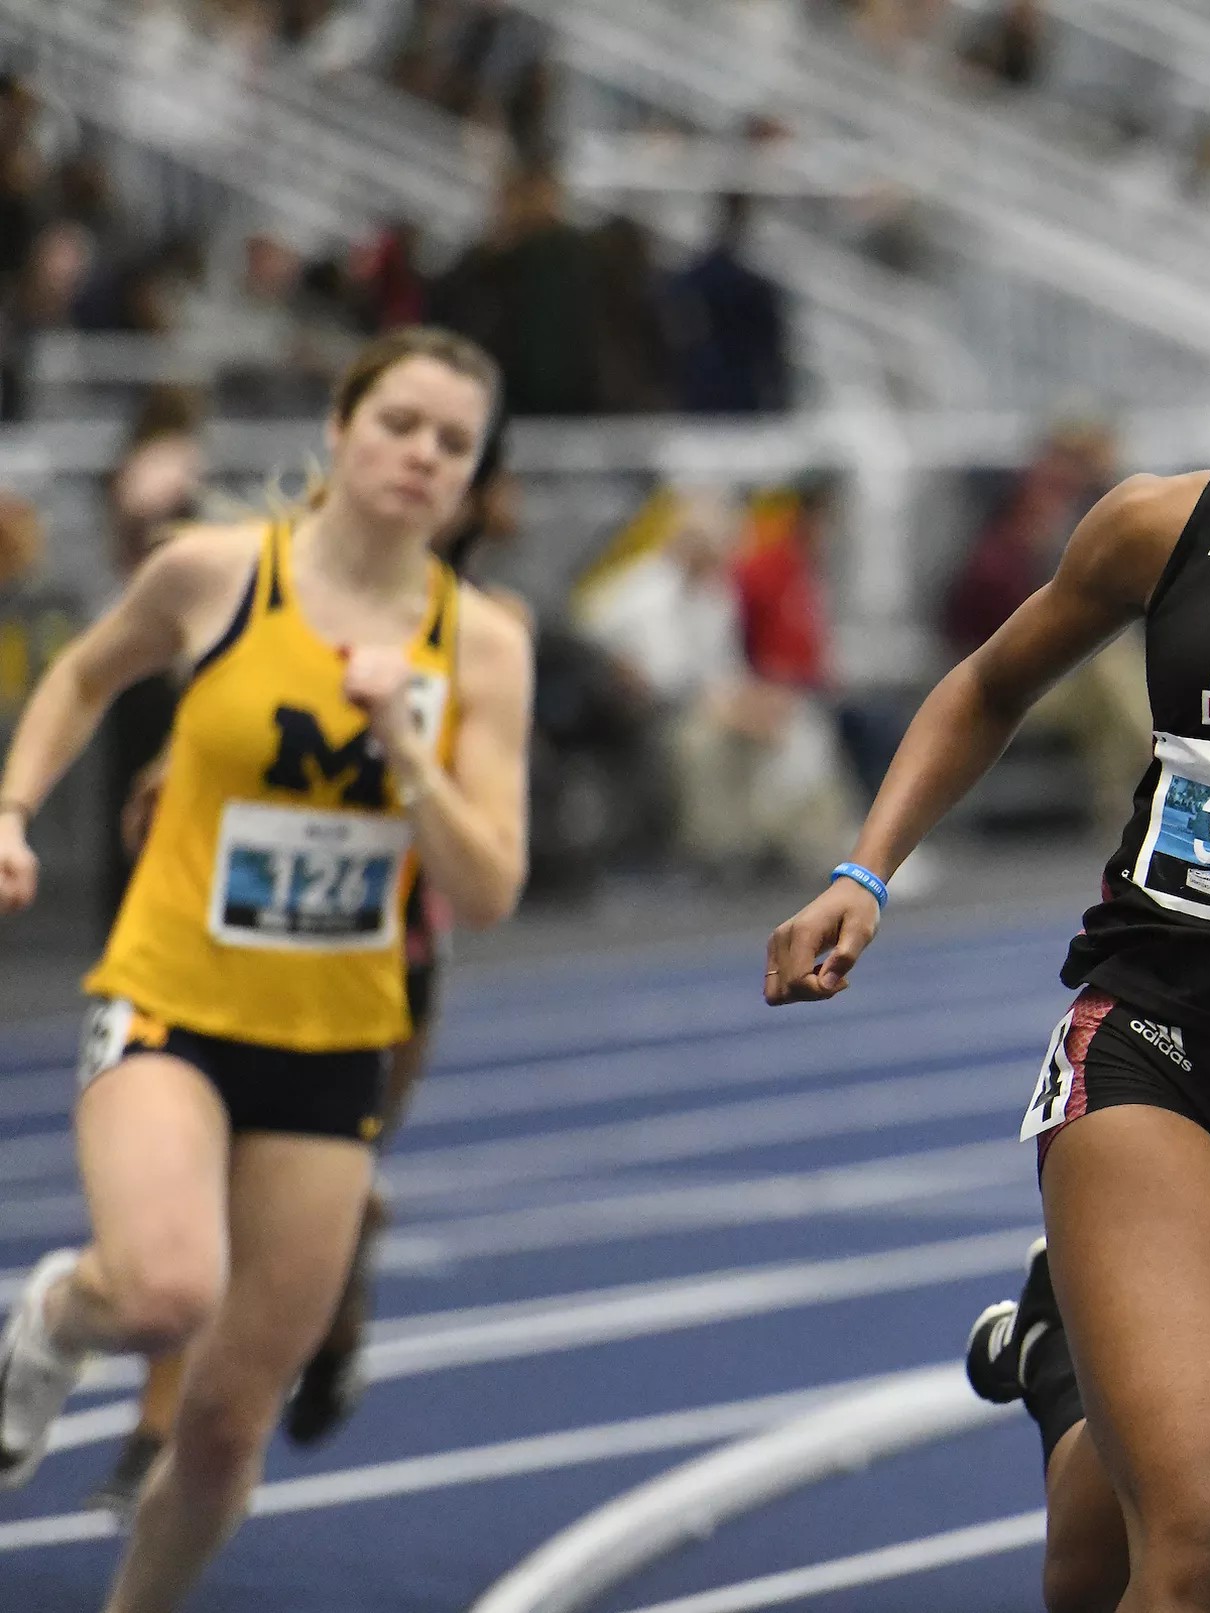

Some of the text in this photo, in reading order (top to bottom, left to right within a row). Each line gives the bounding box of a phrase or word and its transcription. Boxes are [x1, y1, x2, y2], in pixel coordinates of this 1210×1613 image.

[265, 705, 387, 807] M
[1032, 1023, 1067, 1122] 4
[1129, 1018, 1193, 1073] adidas
